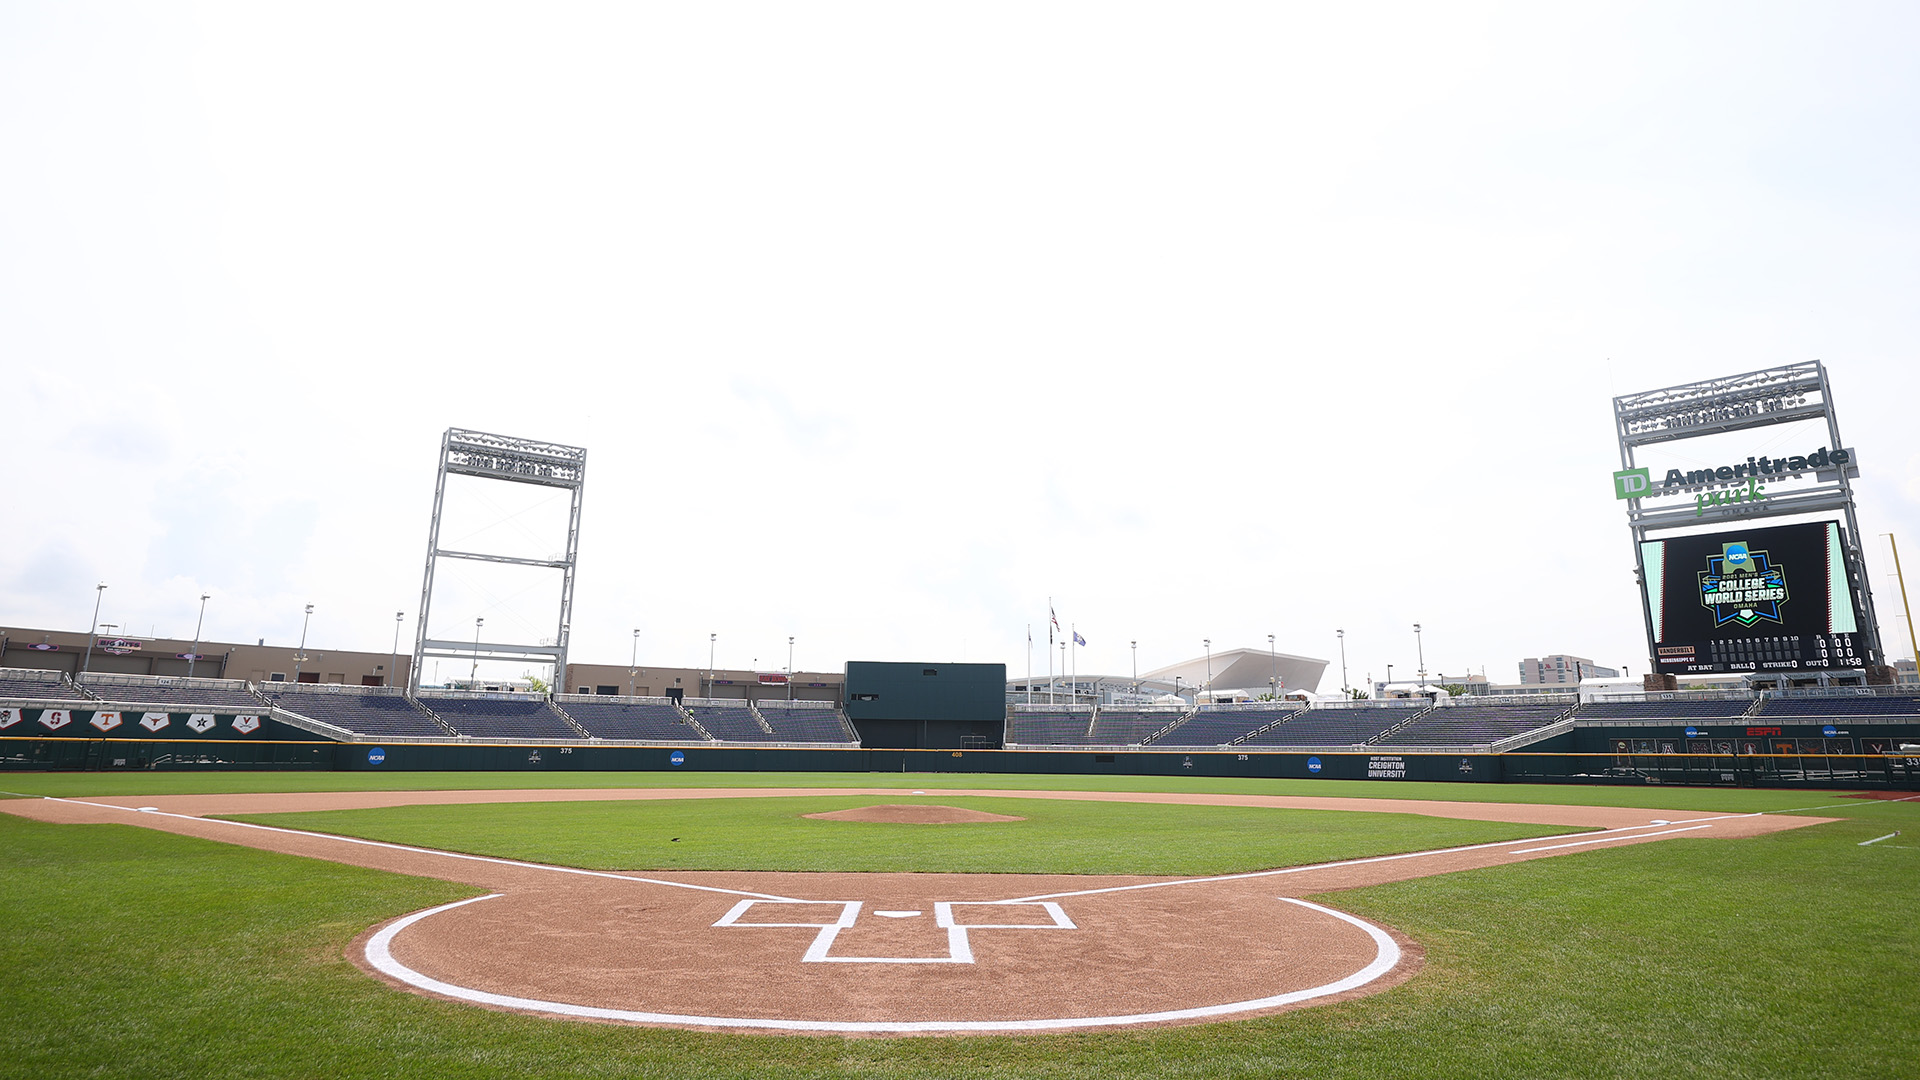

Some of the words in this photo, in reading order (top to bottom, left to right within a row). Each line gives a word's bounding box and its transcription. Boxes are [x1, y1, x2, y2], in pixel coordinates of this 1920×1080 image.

[1617, 474, 1648, 495] TD
[1663, 447, 1849, 489] Ameritrade
[1694, 477, 1767, 517] park
[1728, 553, 1747, 561] NCAA
[1718, 577, 1765, 592] COLLEGE
[1704, 590, 1743, 605] WORLD
[1744, 588, 1785, 602] SERIES
[1659, 647, 1694, 655] VANDERBILT
[1820, 639, 1826, 648] 0
[1835, 638, 1841, 647] 0
[1845, 638, 1851, 647] 0
[1822, 649, 1828, 658] 0
[1837, 648, 1843, 657] 0
[1847, 648, 1853, 657] 0
[1749, 661, 1756, 670] 0
[1791, 660, 1798, 668] 0
[1822, 659, 1829, 667] 0
[101, 713, 115, 725] T
[1746, 727, 1782, 736] ESPN
[1368, 761, 1405, 770] CREIGHTON
[1906, 757, 1920, 767] 33
[1368, 770, 1406, 778] UNIVERSITY
